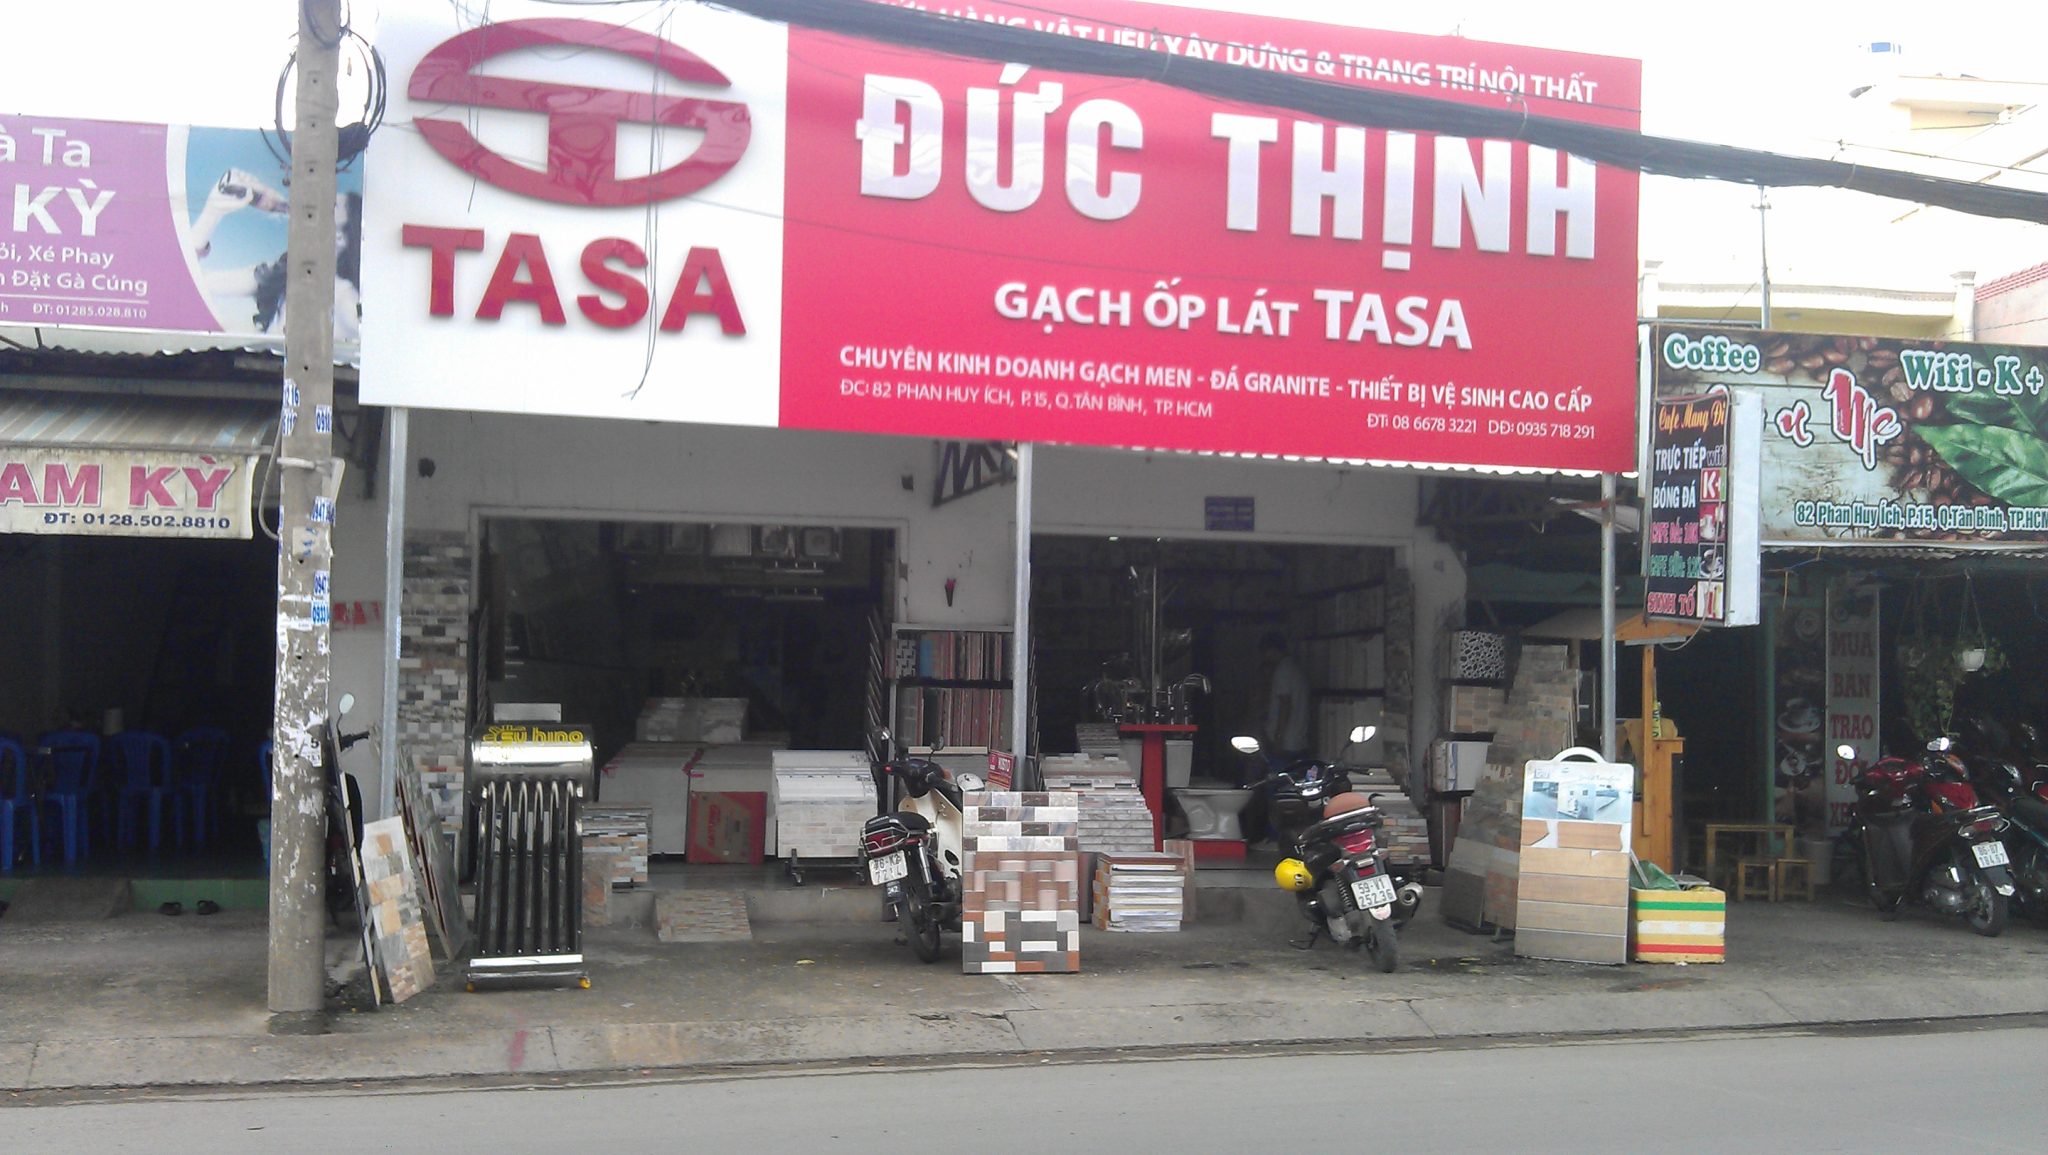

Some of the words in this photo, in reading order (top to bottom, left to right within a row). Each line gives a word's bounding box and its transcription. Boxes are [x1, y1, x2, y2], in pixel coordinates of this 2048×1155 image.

[1314, 51, 1335, 76] &
[1339, 53, 1431, 87] TRANG
[1435, 62, 1476, 92] TRÍ
[1479, 65, 1525, 103] NỘI
[1530, 72, 1598, 104] THẤT
[32, 127, 91, 168] Ta
[855, 61, 1144, 221] ĐỨC
[1211, 111, 1597, 271] THỊNH
[13, 178, 117, 237] KỲ
[28, 245, 55, 262] Xé
[62, 247, 114, 269] Phay
[12, 270, 51, 291] Đặt
[57, 271, 86, 289] Gà
[92, 274, 149, 297] Cúng
[402, 223, 747, 337] TASA
[994, 280, 1131, 334] GẠCH
[1142, 277, 1206, 331] ỐP
[1216, 288, 1300, 338] LÁT
[1313, 288, 1473, 350] TASA
[840, 345, 932, 372] CHUYÊN
[938, 352, 990, 376] KINH
[995, 355, 1075, 382] DOANH
[1079, 361, 1140, 389] GẠCH
[1145, 366, 1192, 389] MEN
[1210, 365, 1240, 392] ĐÁ
[1244, 372, 1330, 397] GRANITE
[1348, 374, 1404, 402] THIẾT
[1407, 382, 1427, 409] BỊ
[1431, 381, 1457, 410] VỆ
[1461, 387, 1505, 409] SINH
[1509, 390, 1549, 410] CAO
[1554, 386, 1593, 413] CẤP
[1665, 334, 1759, 372] Coffee
[1901, 351, 1973, 392] Wifi
[872, 381, 892, 398] 82
[897, 382, 943, 401] PHAN
[946, 384, 980, 404] HUY
[984, 384, 1015, 408] ÍCH,
[1107, 392, 1148, 417] BÌNH,
[1392, 415, 1410, 430] 08
[1413, 416, 1446, 432] 6678
[1449, 418, 1477, 433] 3221
[1516, 421, 1547, 438] 0935
[1550, 423, 1571, 439] 718
[1574, 424, 1595, 440] 291
[1659, 405, 1680, 435] Cafe
[1681, 402, 1709, 433] Mang
[1655, 444, 1681, 475] TRỰC
[1683, 438, 1707, 470] TIẾP
[129, 455, 236, 511] KỲ
[1653, 481, 1680, 508] BÓNG
[1682, 480, 1696, 508] ĐÁ
[44, 512, 77, 526] ĐT:
[83, 513, 231, 530] 0128.502.8810
[1794, 501, 1814, 525] 82
[1816, 502, 1850, 527] Phan
[1853, 504, 1878, 529] Huy
[1830, 714, 1873, 740] TRAO
